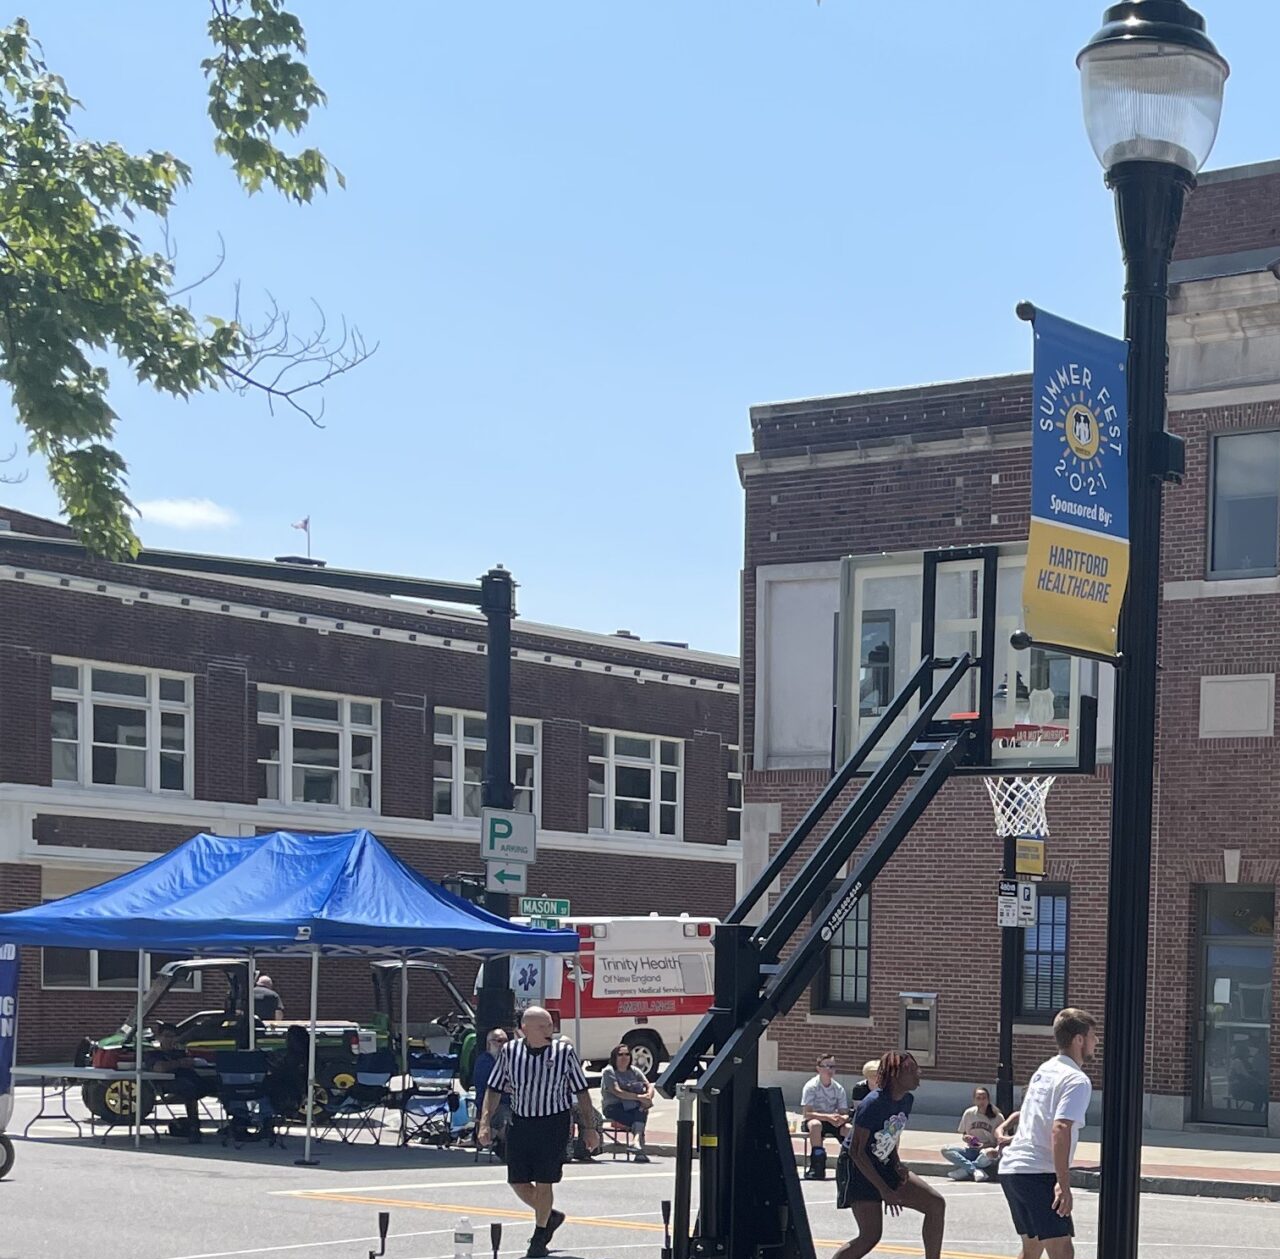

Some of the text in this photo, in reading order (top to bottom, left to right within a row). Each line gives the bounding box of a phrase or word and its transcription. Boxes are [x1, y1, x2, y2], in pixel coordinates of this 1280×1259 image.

[1039, 363, 1122, 456] SUMMER FEST
[1050, 494, 1113, 528] Sponsored By:
[1049, 545, 1109, 578] HARTFORD
[1037, 569, 1112, 604] HEALTHCARE
[523, 900, 558, 914] MASON
[599, 956, 681, 973] Trinity Health
[614, 975, 630, 983] New
[631, 974, 662, 985] England
[617, 1000, 676, 1013] AMBULANCE
